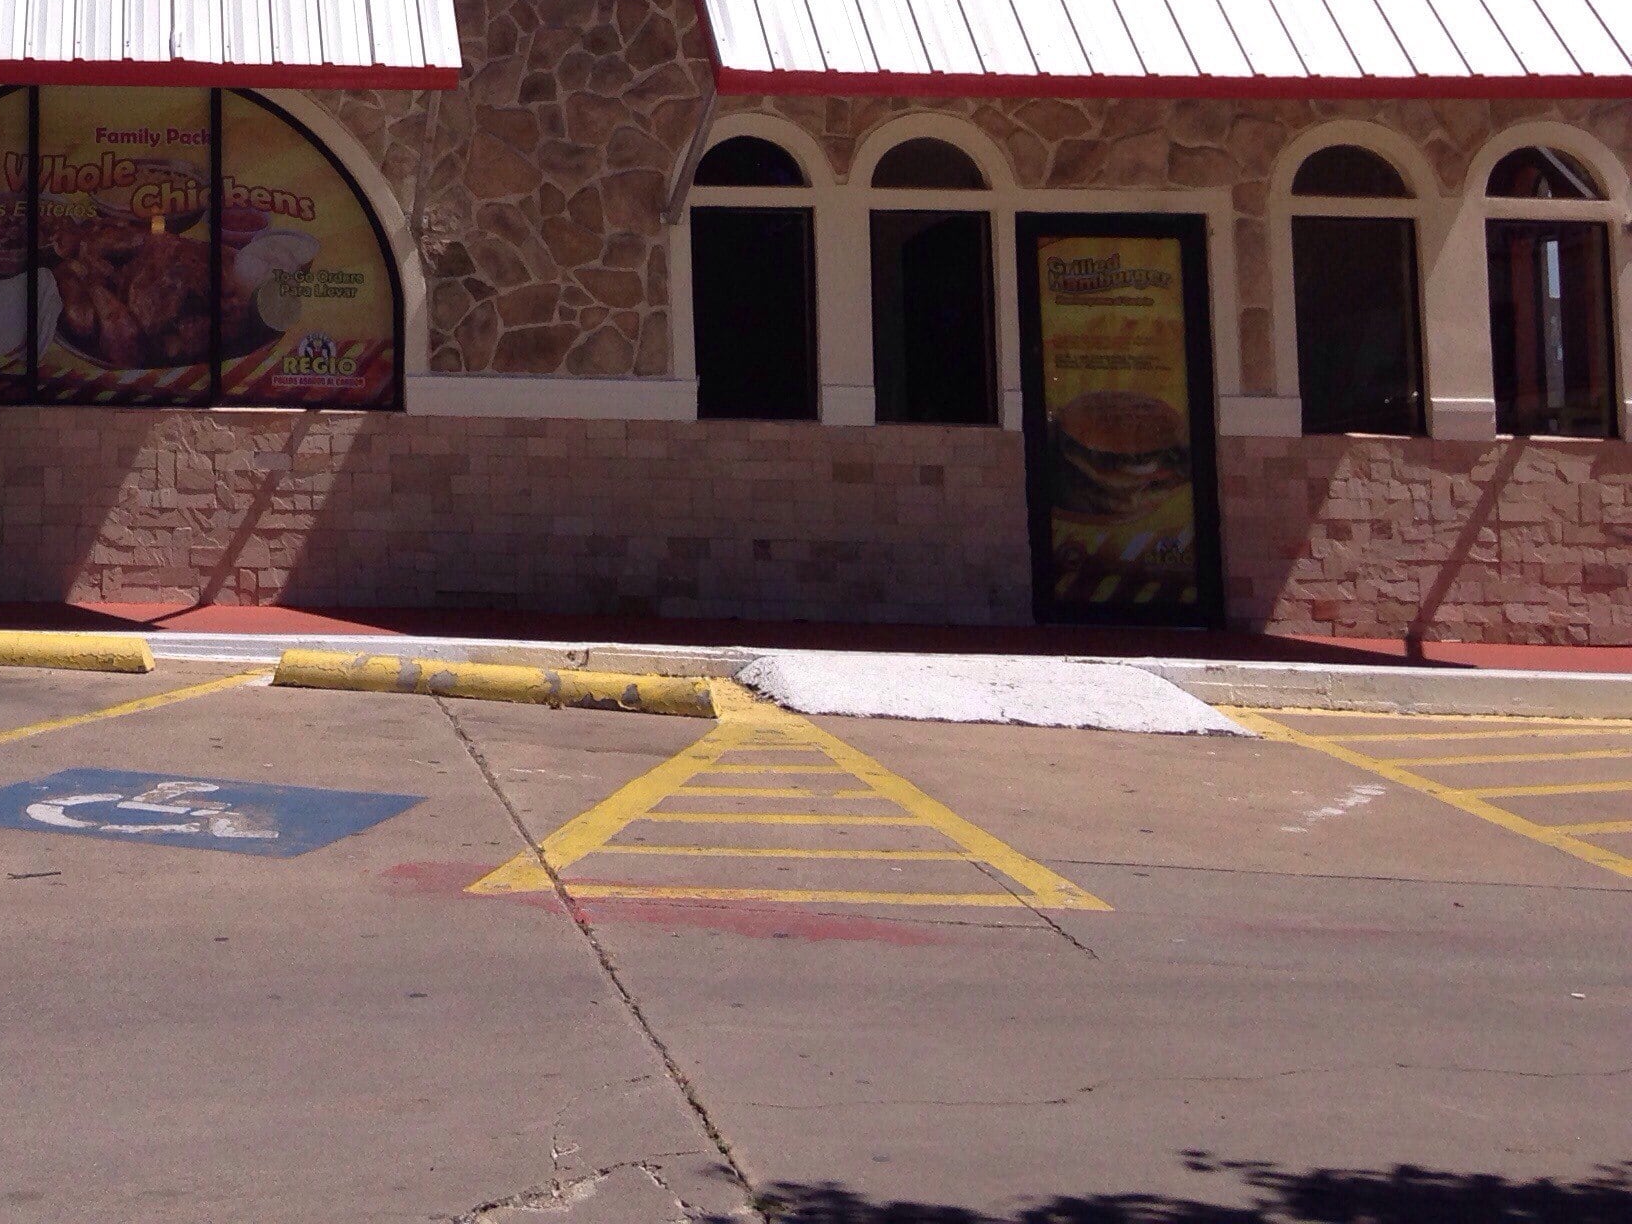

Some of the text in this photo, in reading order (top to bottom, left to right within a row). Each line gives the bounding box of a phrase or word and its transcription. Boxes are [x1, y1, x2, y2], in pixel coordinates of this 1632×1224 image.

[95, 127, 161, 147] Family
[4, 151, 137, 194] Whole
[282, 356, 357, 376] REGIO
